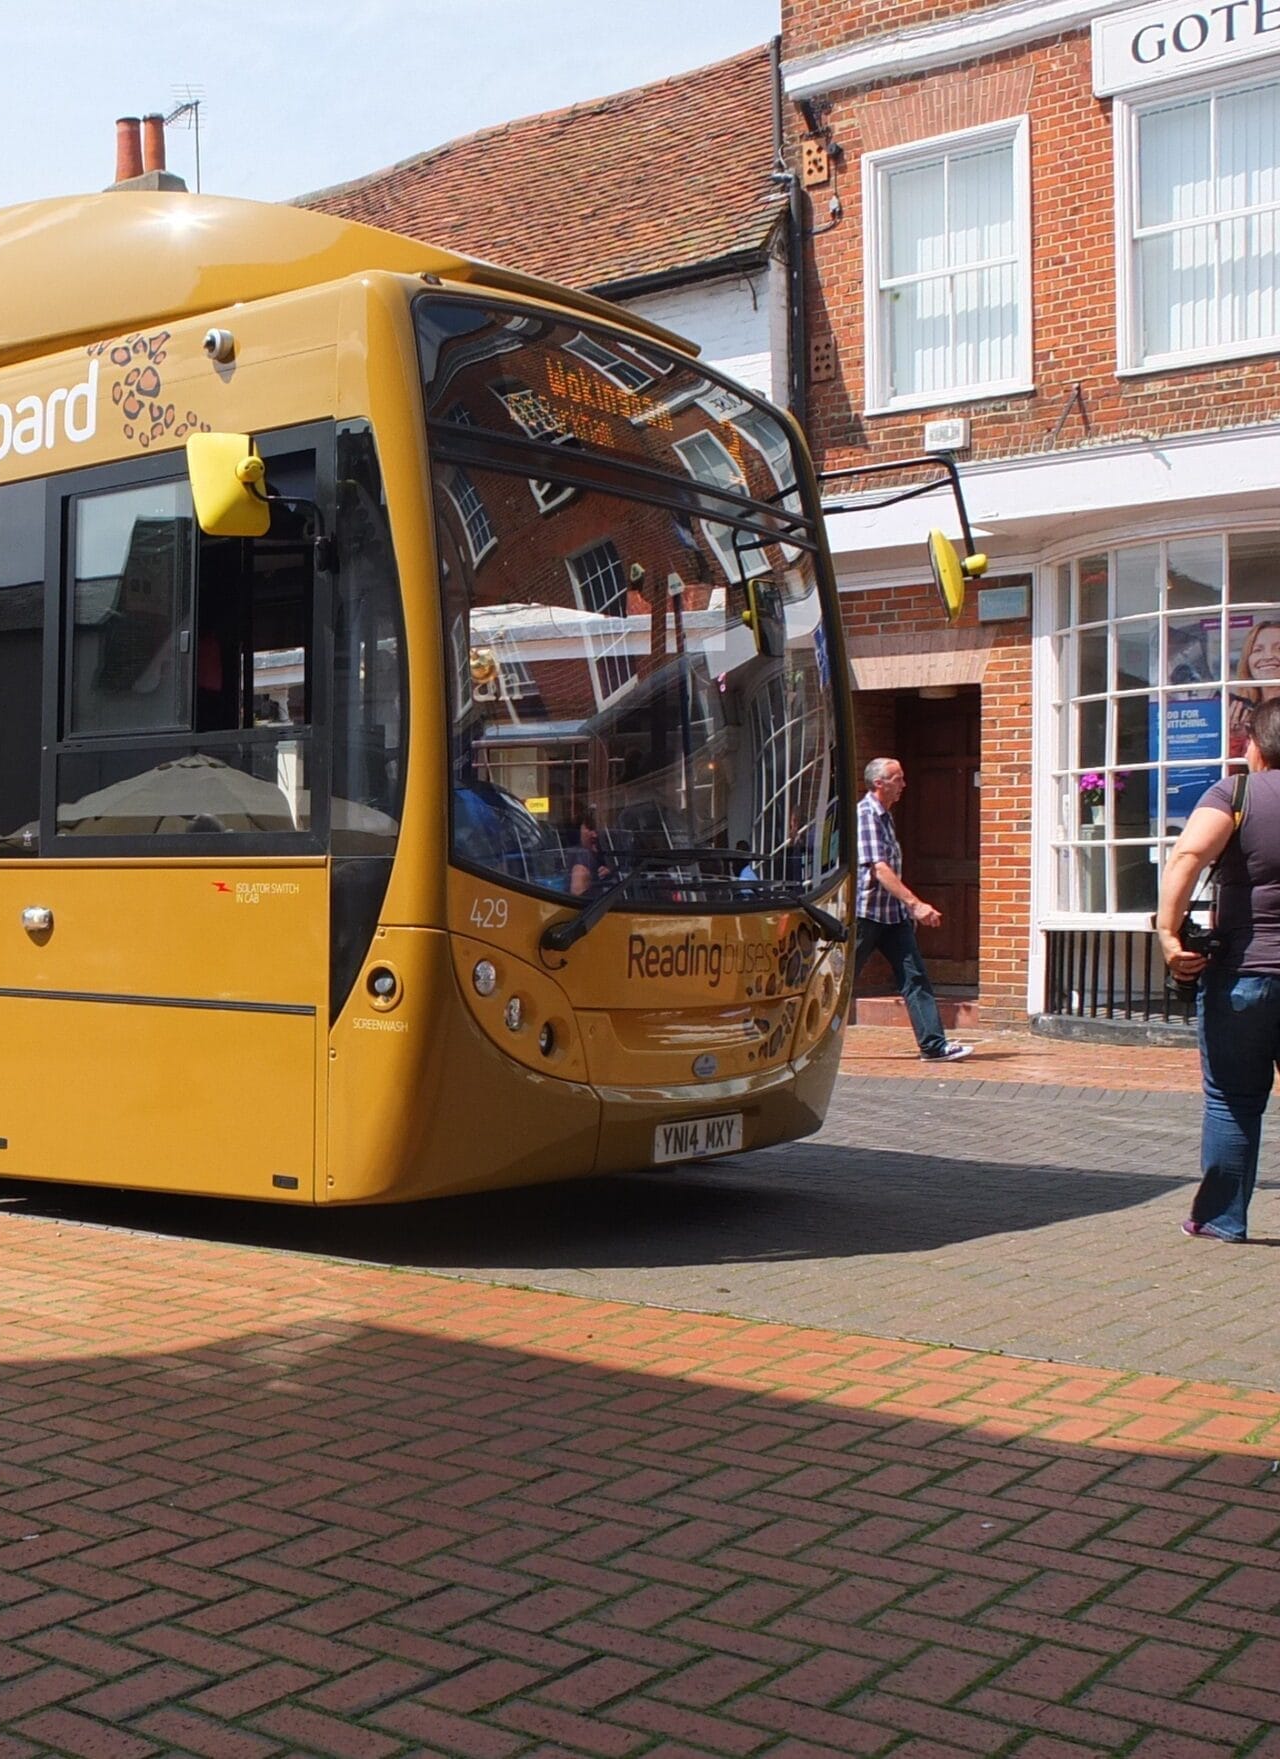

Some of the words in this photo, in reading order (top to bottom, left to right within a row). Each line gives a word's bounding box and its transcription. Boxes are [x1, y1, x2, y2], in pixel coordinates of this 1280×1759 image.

[236, 882, 270, 894] ISOLATOR
[271, 883, 300, 894] SWITCH
[236, 894, 243, 903] IN
[244, 893, 260, 904] CAB
[470, 897, 508, 928] 429
[353, 1018, 409, 1032] SCREENWASH
[663, 1125, 699, 1155] YN14
[705, 1119, 735, 1149] MXY
